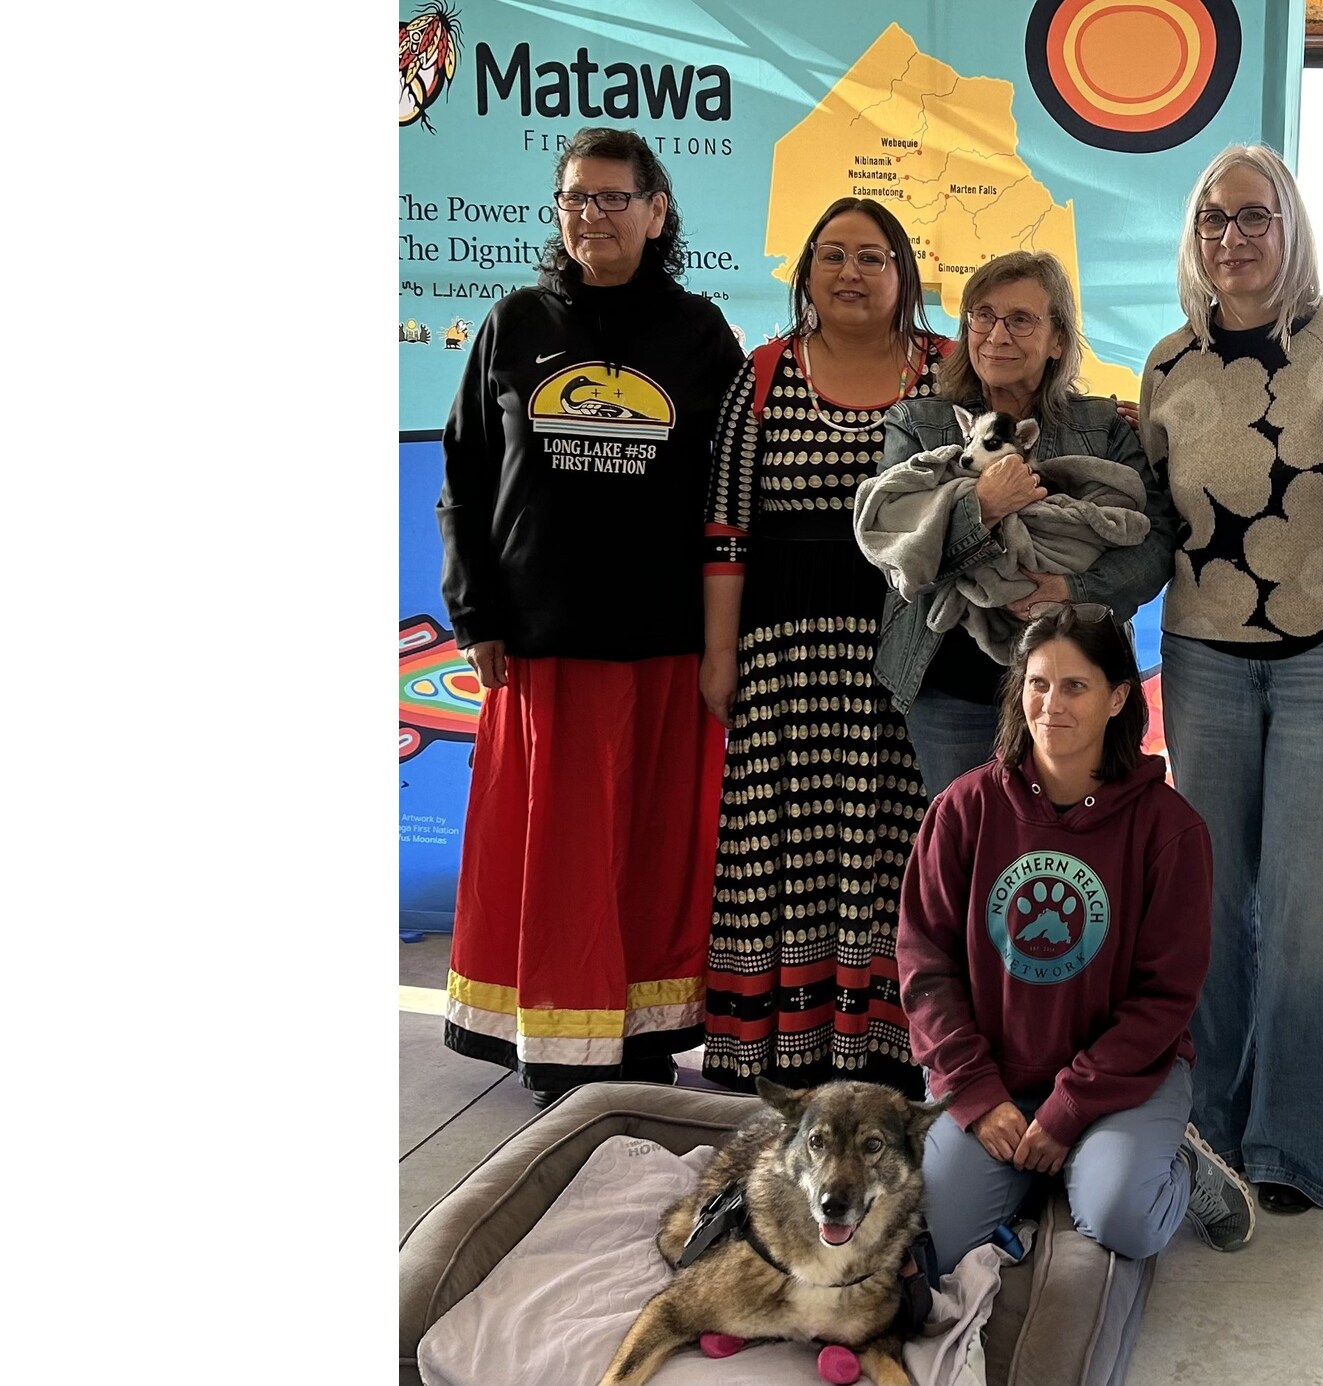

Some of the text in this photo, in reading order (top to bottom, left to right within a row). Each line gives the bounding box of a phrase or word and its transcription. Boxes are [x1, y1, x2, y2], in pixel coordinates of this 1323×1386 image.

[475, 42, 732, 122] Matawa
[524, 130, 732, 155] FIR TIONS
[881, 138, 918, 148] Webequie
[855, 156, 892, 166] Nibinamik
[848, 169, 897, 181] Neskantanga
[950, 184, 997, 195] Marten Falls
[447, 197, 530, 223] Power
[938, 263, 981, 274] Ginoogami
[544, 438, 657, 460] LONG LAKE #58
[552, 454, 646, 475] FIRST NATION
[402, 814, 447, 826] Artwork by
[433, 826, 460, 835] Nation
[992, 857, 1103, 923] NORTHERN REACH
